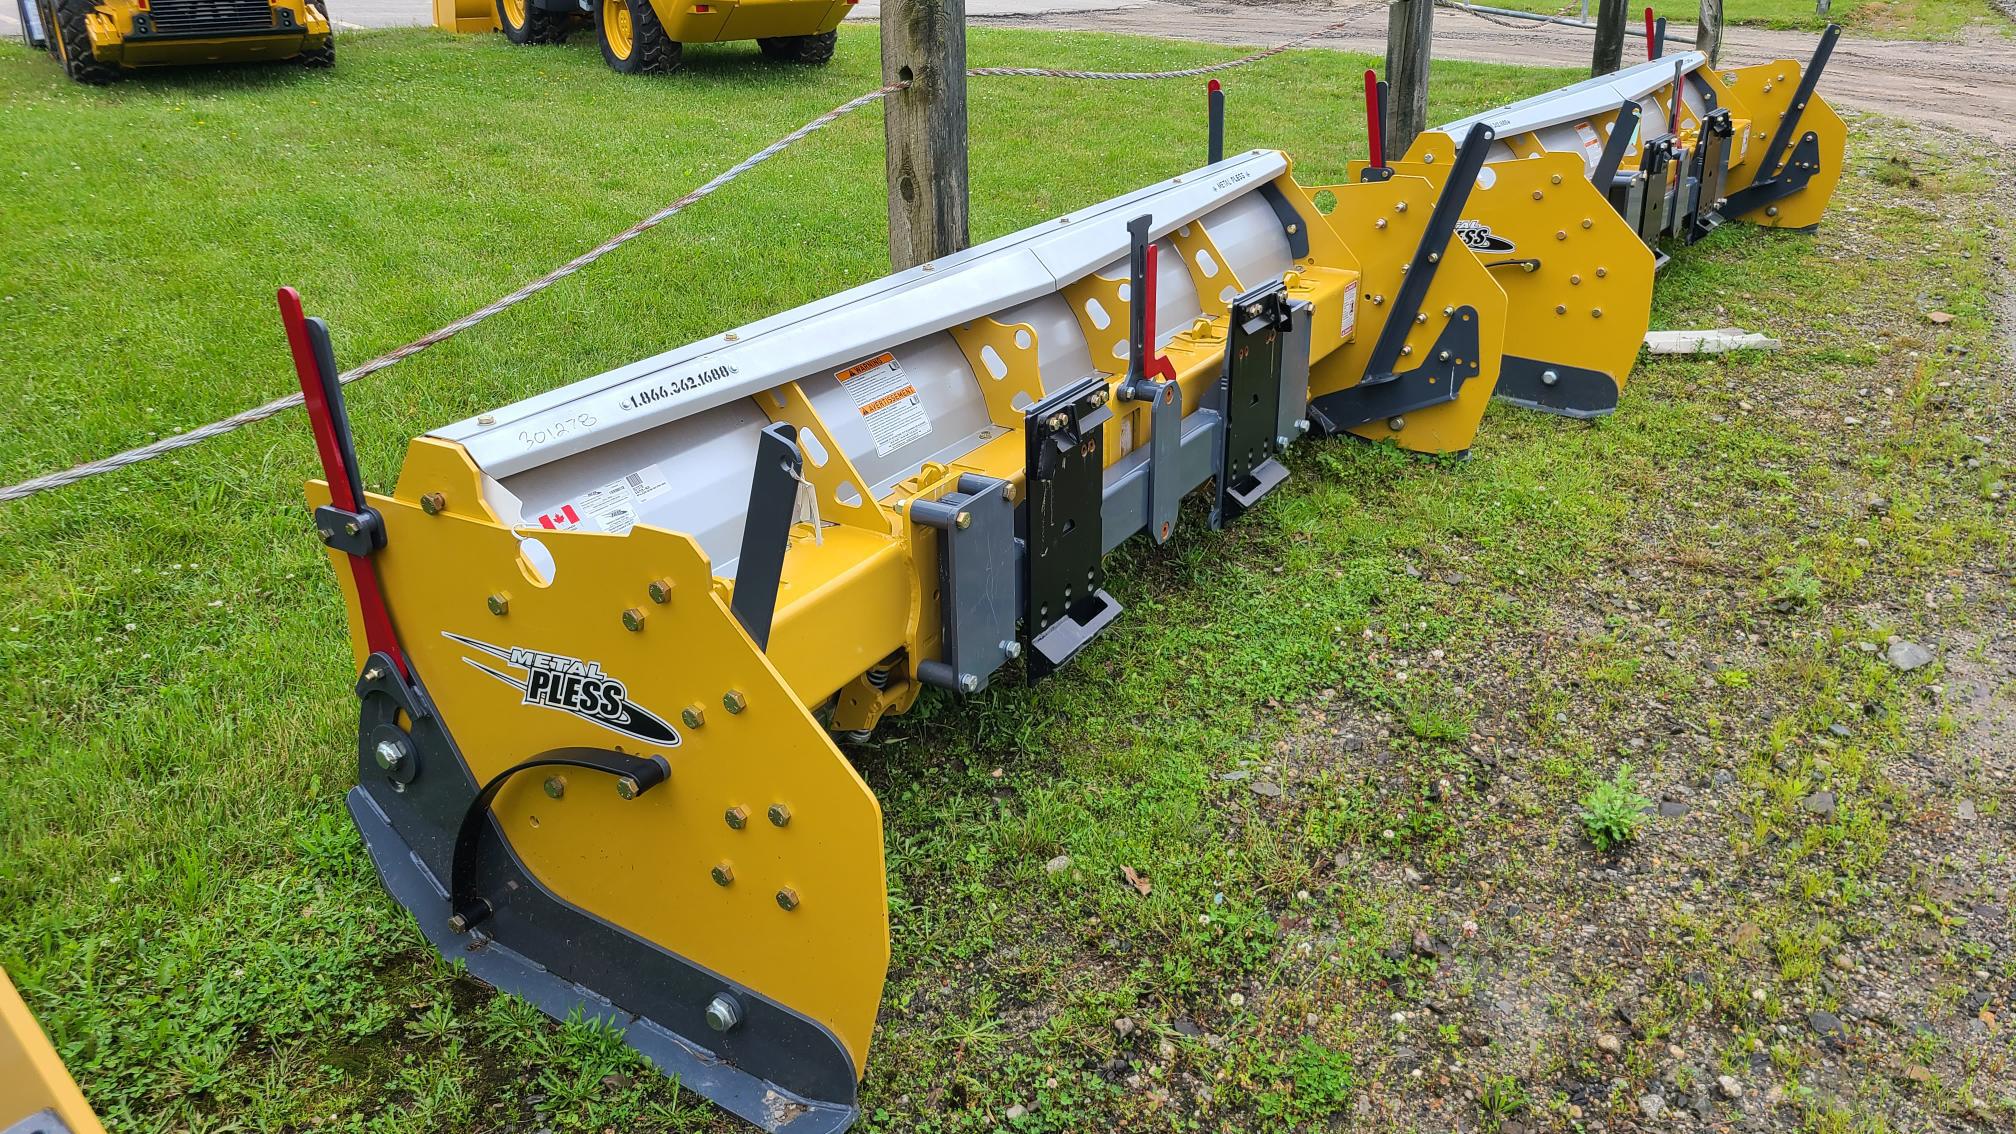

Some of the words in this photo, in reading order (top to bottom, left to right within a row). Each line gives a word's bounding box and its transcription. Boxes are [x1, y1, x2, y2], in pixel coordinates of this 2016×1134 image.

[856, 358, 883, 373] WARNING
[630, 365, 730, 408] 1.866.362.1688
[868, 386, 914, 412] AVERTISSEMENT
[510, 648, 606, 681] METAL
[529, 670, 624, 718] PLESS
